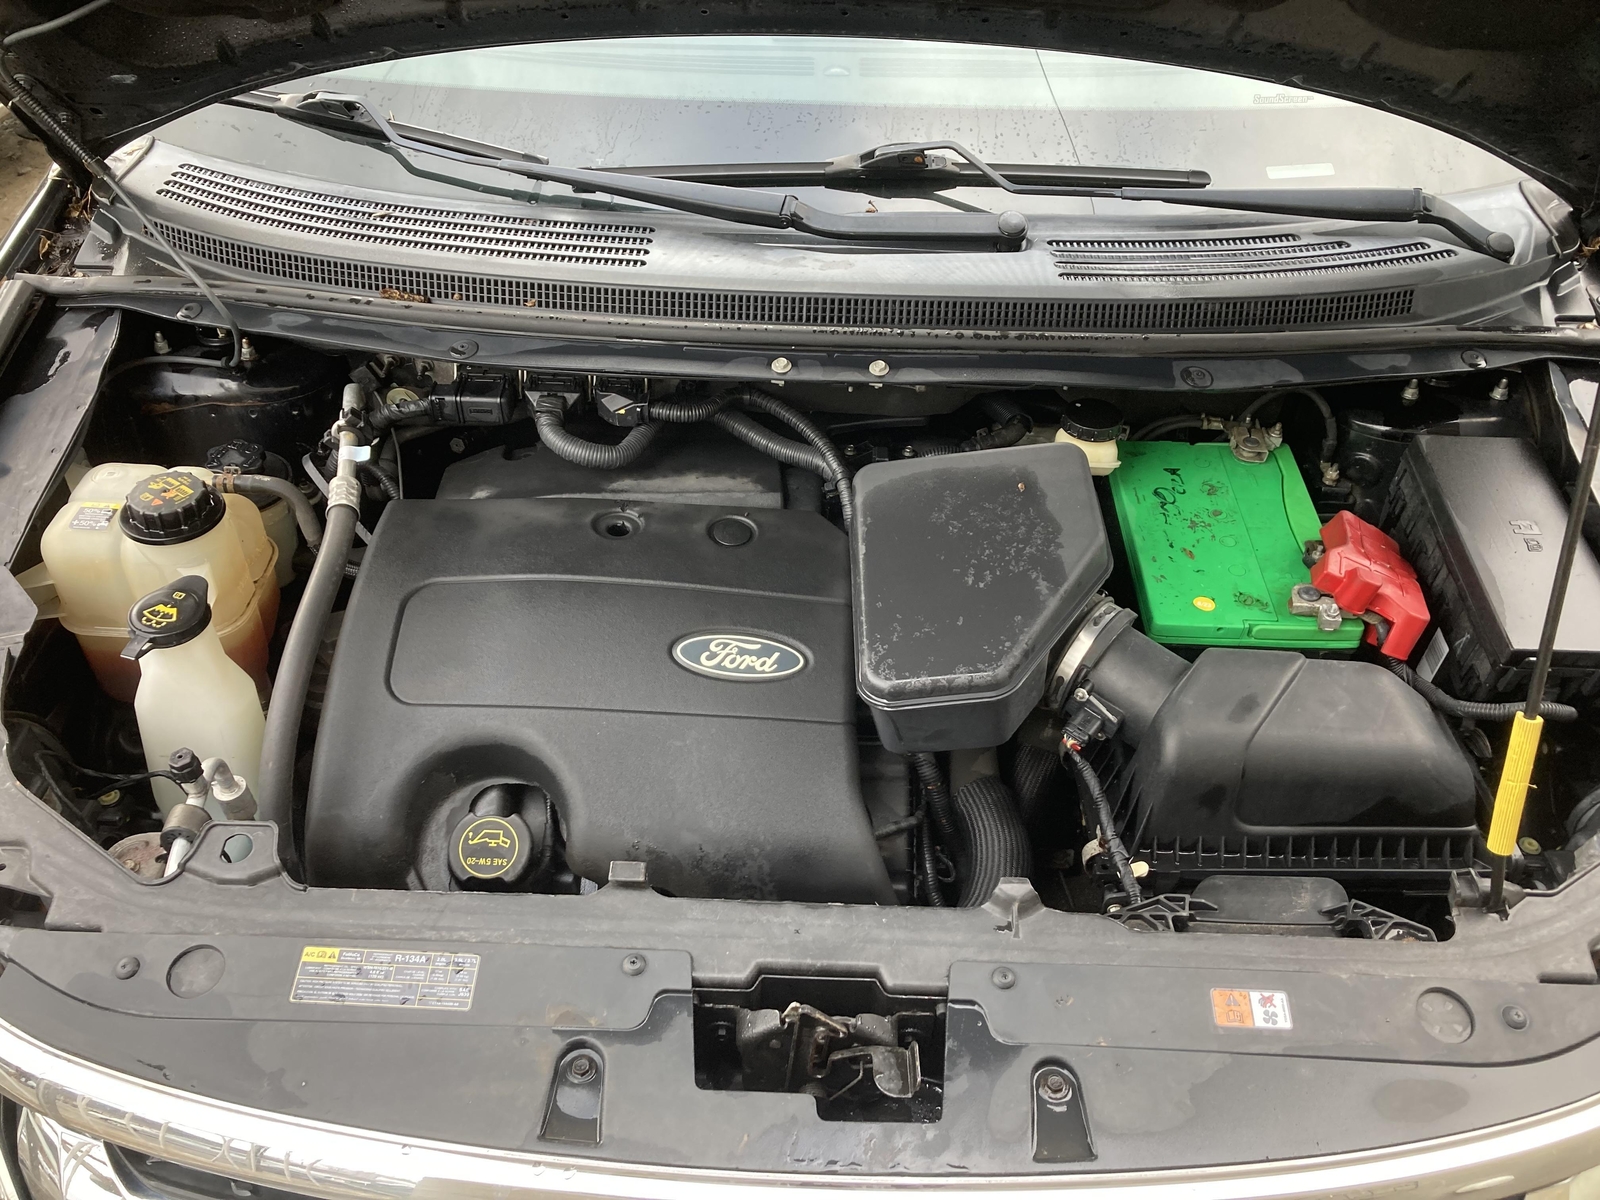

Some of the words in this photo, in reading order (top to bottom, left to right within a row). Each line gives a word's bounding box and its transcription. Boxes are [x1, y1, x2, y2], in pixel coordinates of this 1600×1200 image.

[1253, 93, 1308, 104] SoundScreen
[699, 638, 780, 672] Ford
[466, 857, 492, 865] 5W-20
[492, 857, 507, 866] SAE
[394, 954, 426, 964] R-134A
